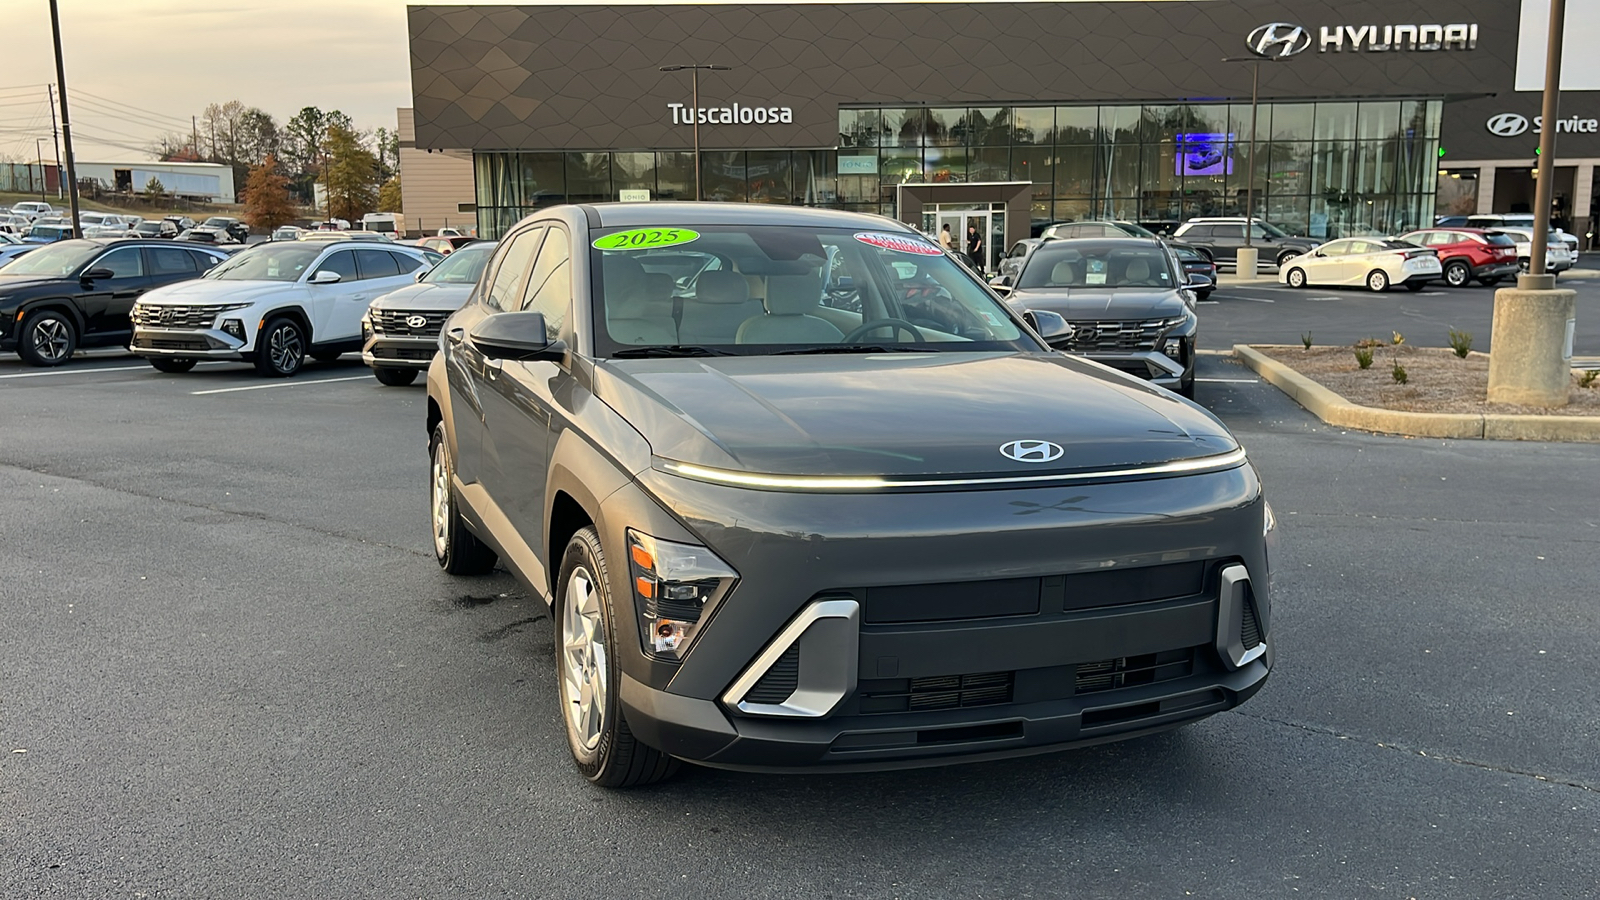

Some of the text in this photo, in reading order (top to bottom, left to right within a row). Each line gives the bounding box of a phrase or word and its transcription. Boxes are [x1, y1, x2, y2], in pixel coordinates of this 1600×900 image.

[1318, 23, 1478, 52] HYUNDAI
[667, 102, 793, 125] Tuscaloosa
[1531, 115, 1599, 134] Srvice
[613, 230, 680, 249] 2025
